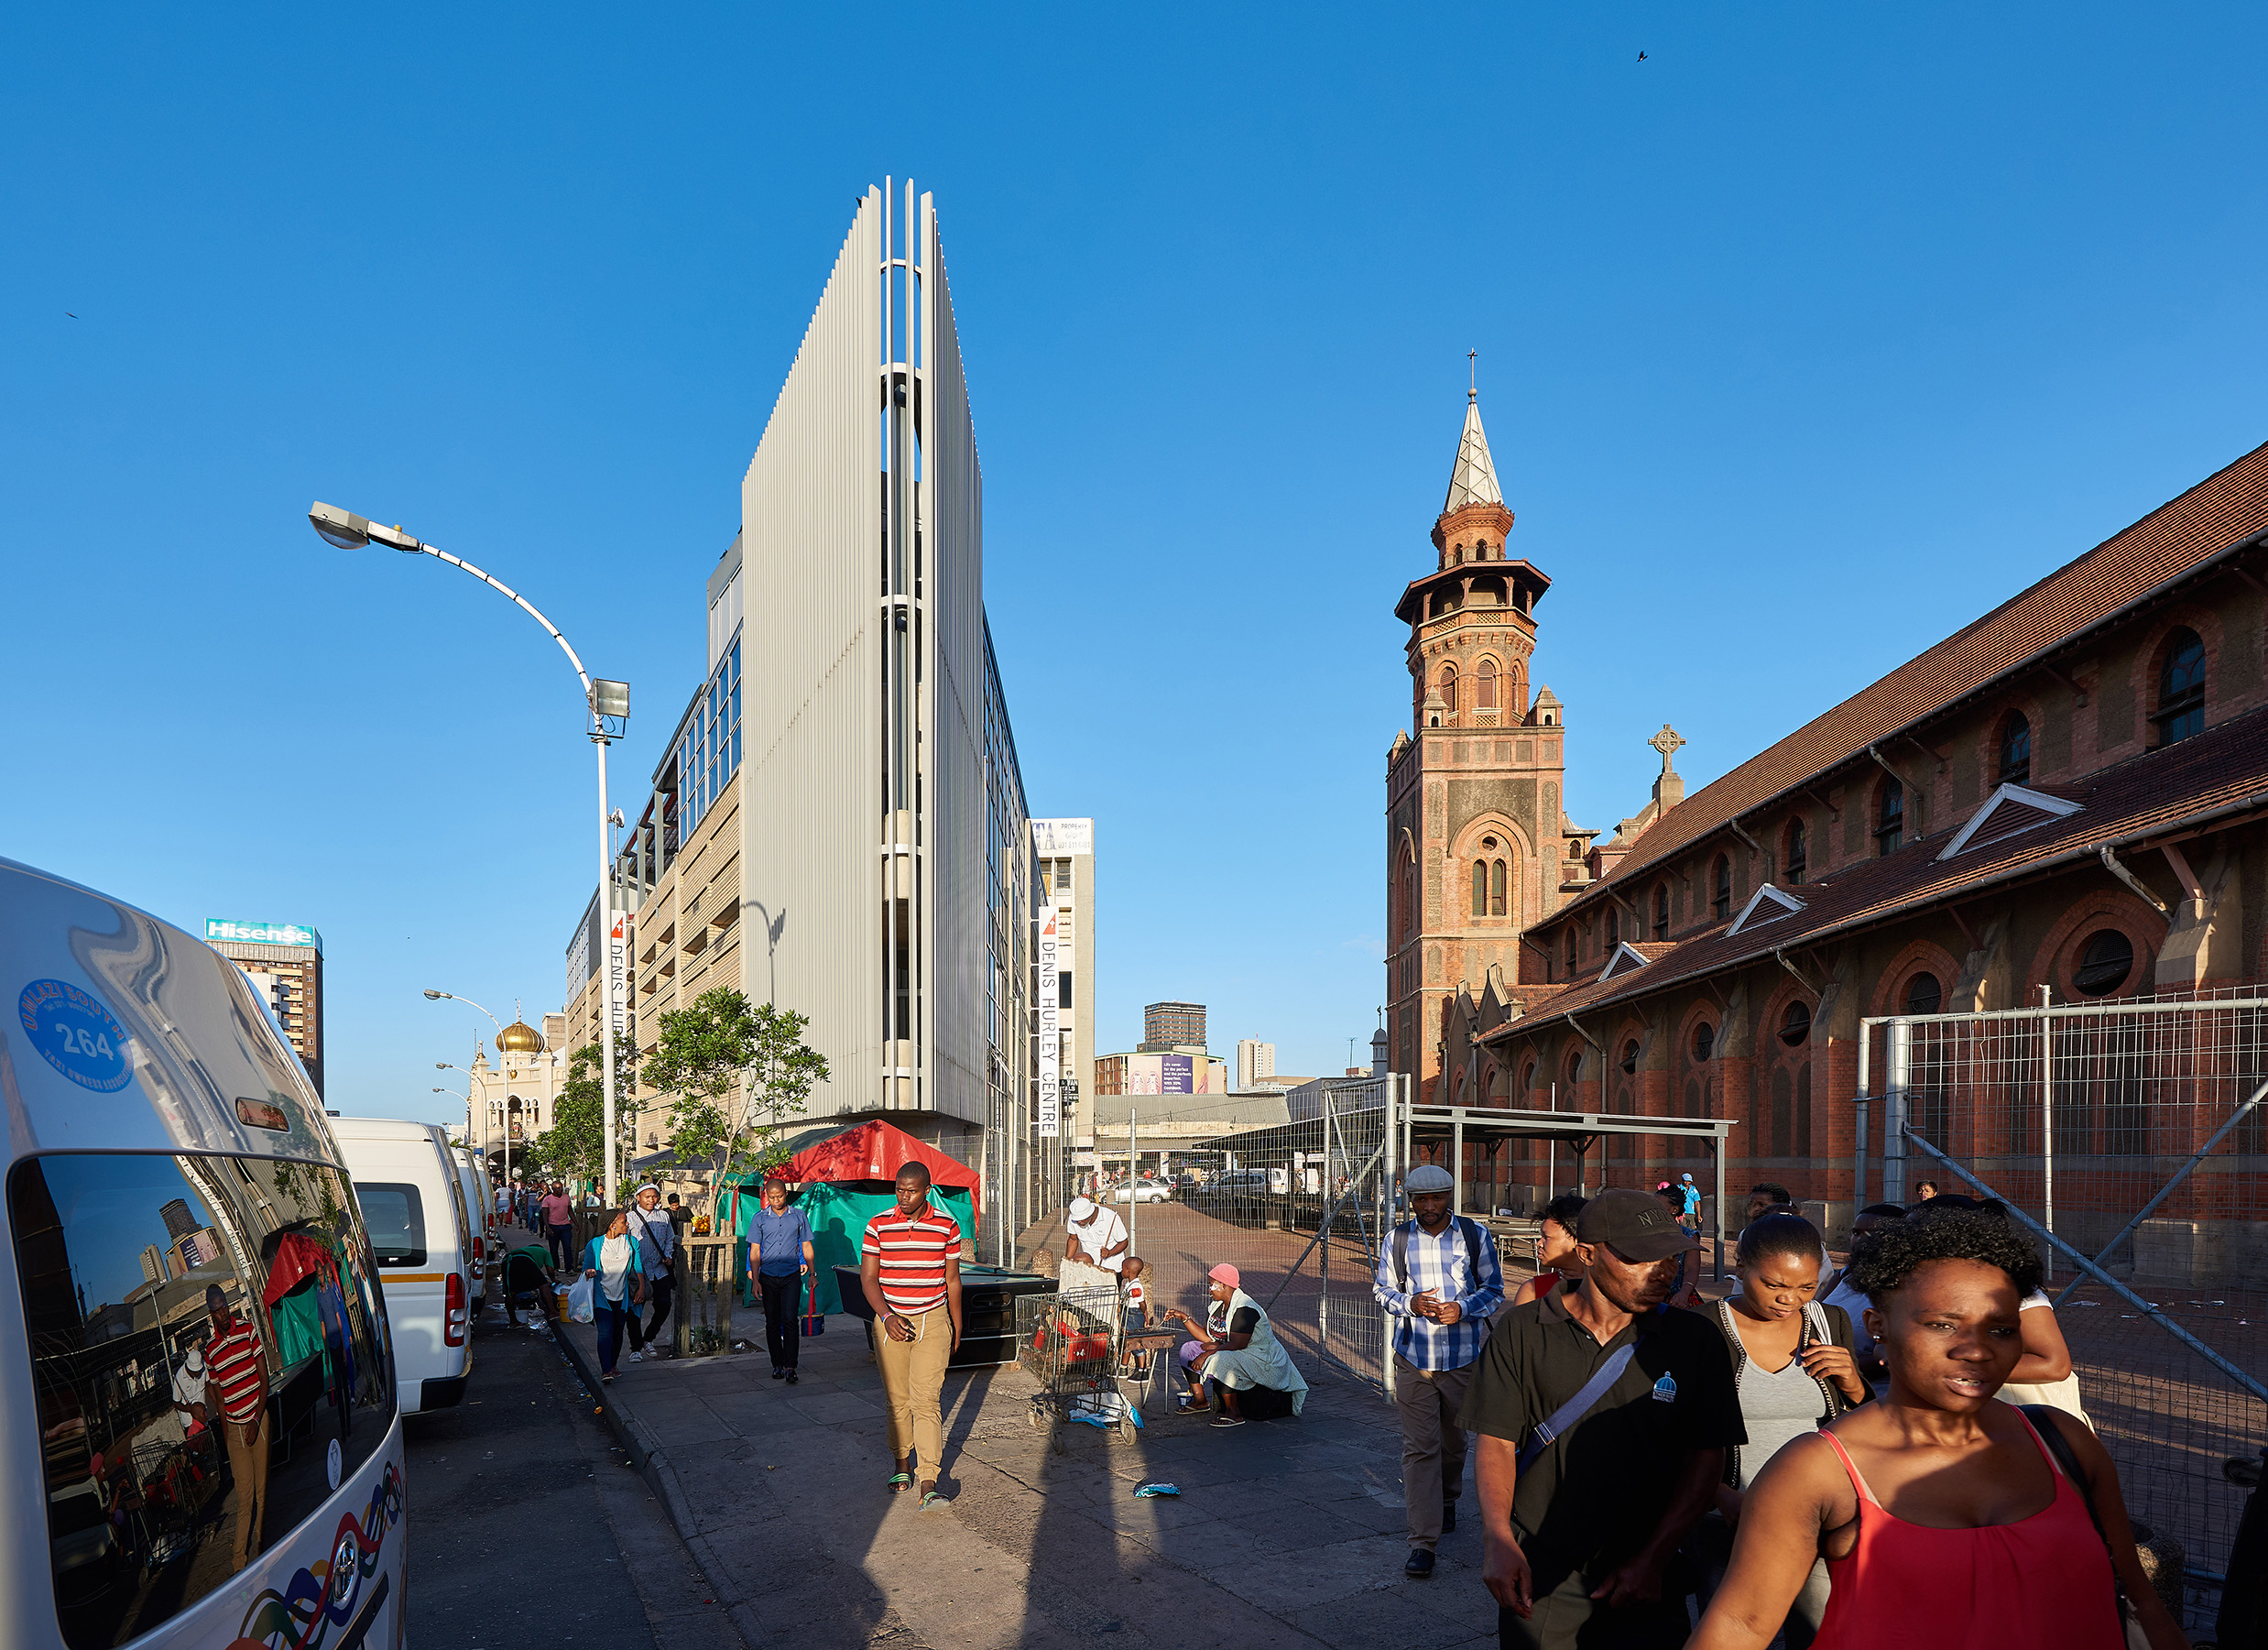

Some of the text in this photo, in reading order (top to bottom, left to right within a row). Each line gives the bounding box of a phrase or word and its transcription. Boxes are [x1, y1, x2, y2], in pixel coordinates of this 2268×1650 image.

[208, 921, 312, 944] Hisense
[21, 982, 125, 1041] UMLAZI SOUTH
[55, 1022, 114, 1061] 264
[1041, 942, 1056, 1131] DENIS HURLEY CENTRE
[45, 1049, 66, 1073] TAXI
[68, 1068, 104, 1090] OWNERS
